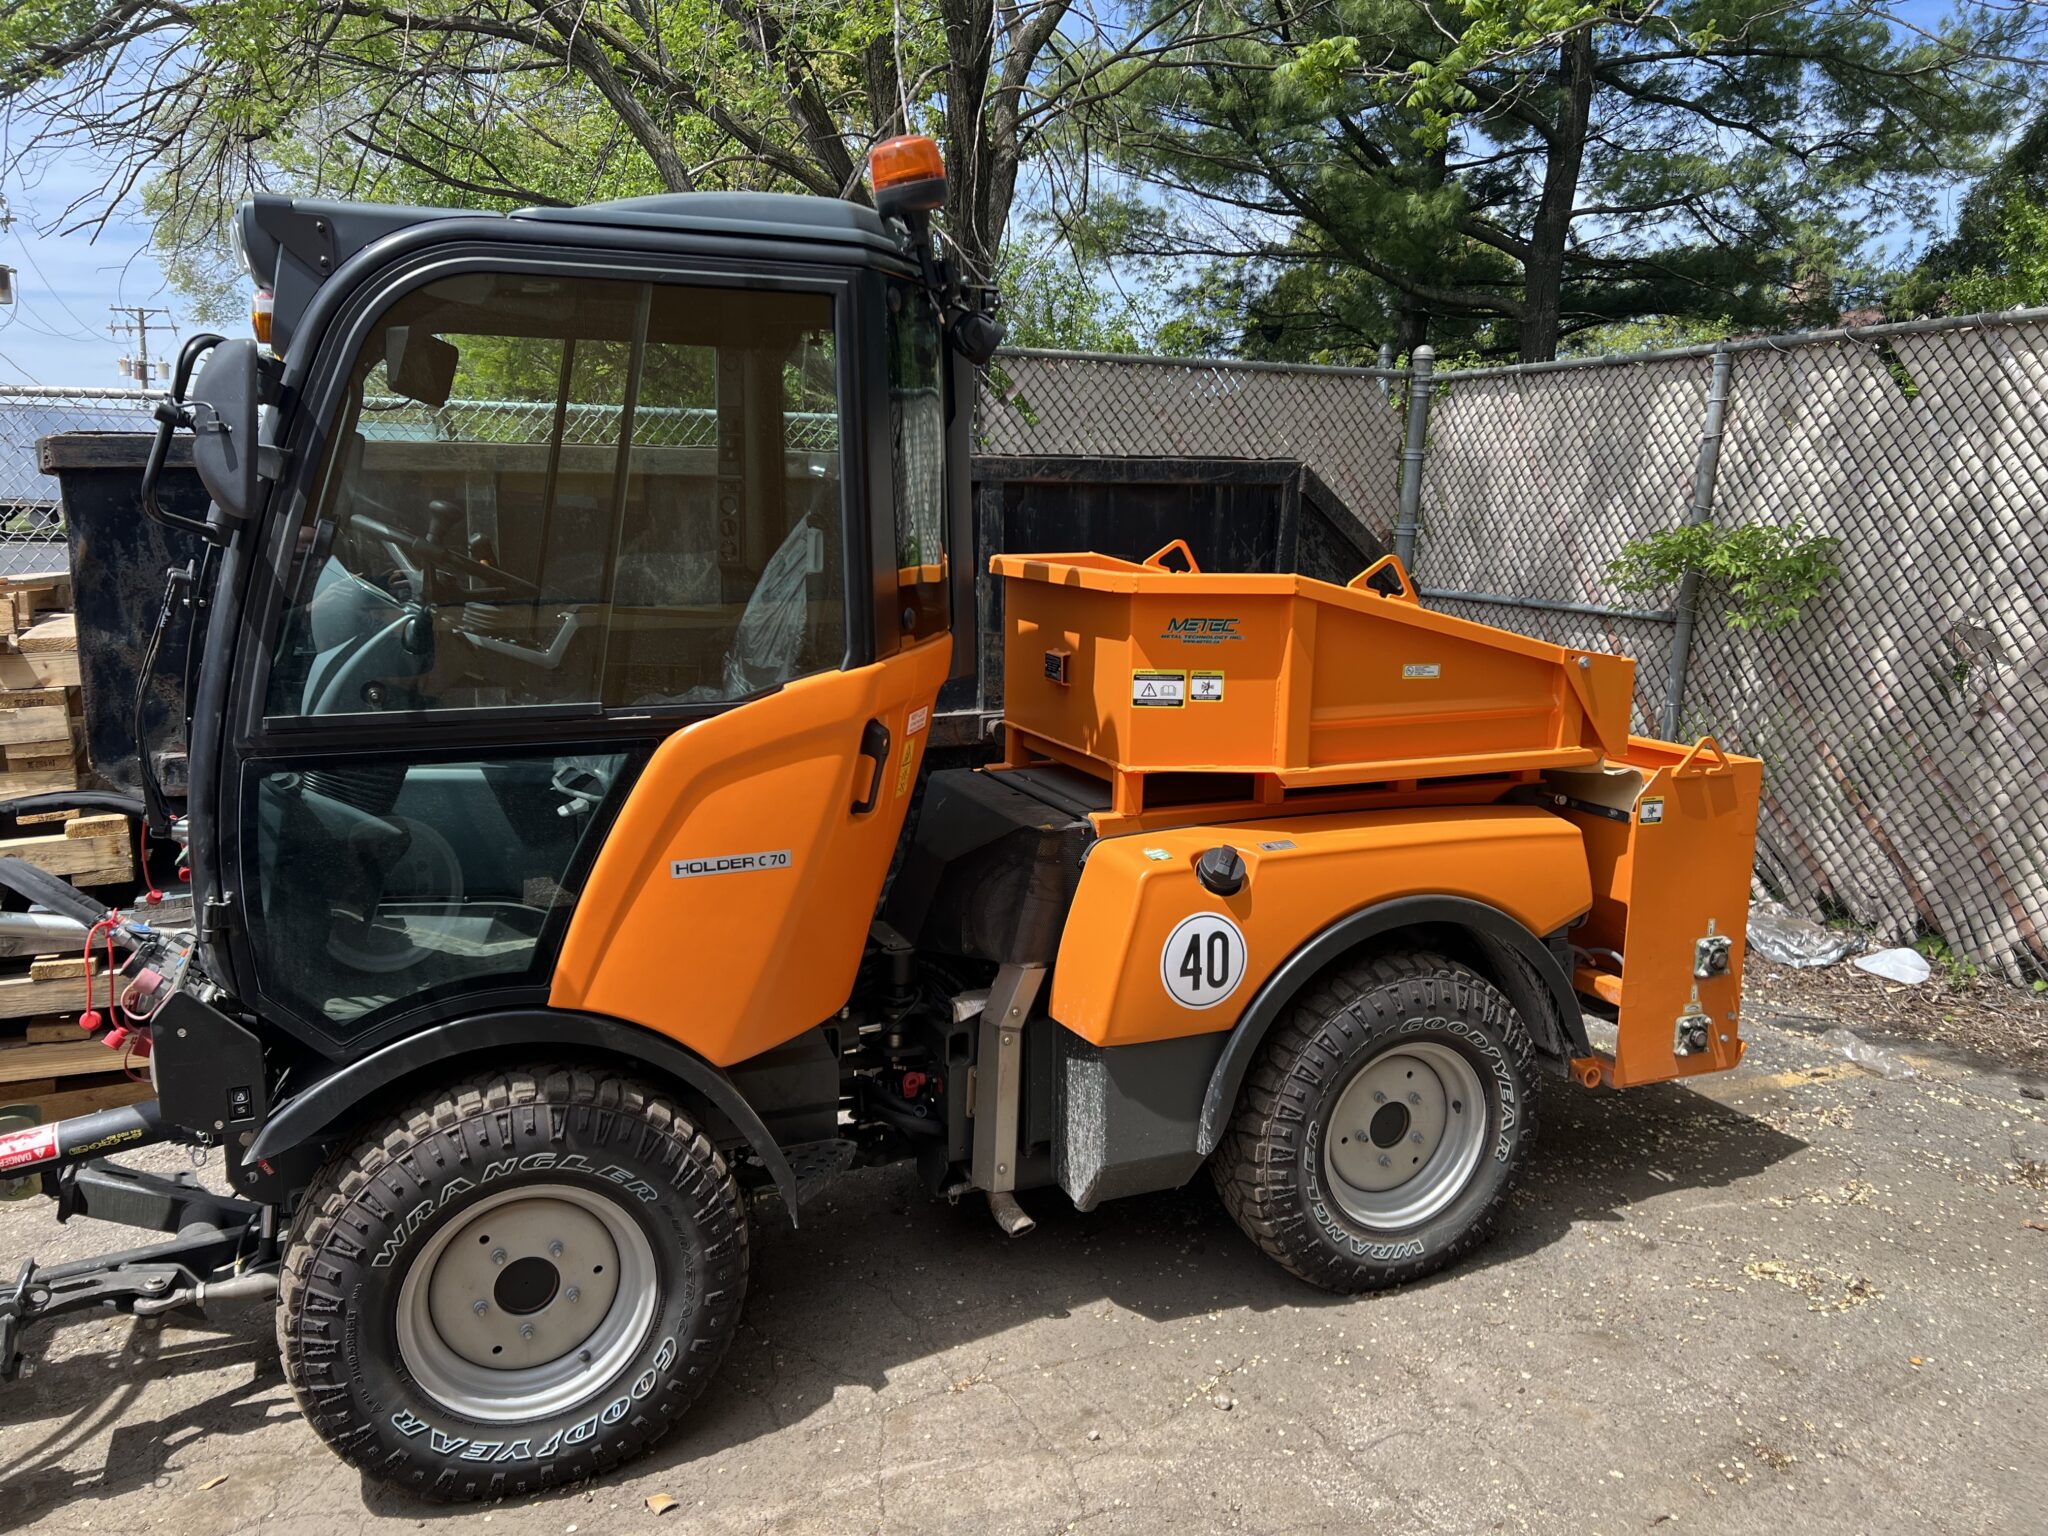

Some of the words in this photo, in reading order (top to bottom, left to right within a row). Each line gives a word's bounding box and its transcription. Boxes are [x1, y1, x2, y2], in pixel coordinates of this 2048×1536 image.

[1167, 618, 1239, 633] METEC
[675, 857, 754, 875] HOLDER
[758, 856, 766, 866] C
[770, 854, 786, 865] 70
[1180, 930, 1229, 991] 40
[1400, 1016, 1515, 1163] GOODYEAR
[372, 1153, 658, 1268] WRANGLER
[1304, 1120, 1425, 1260] WRANGLER
[392, 1336, 678, 1462] GOODYEAR
